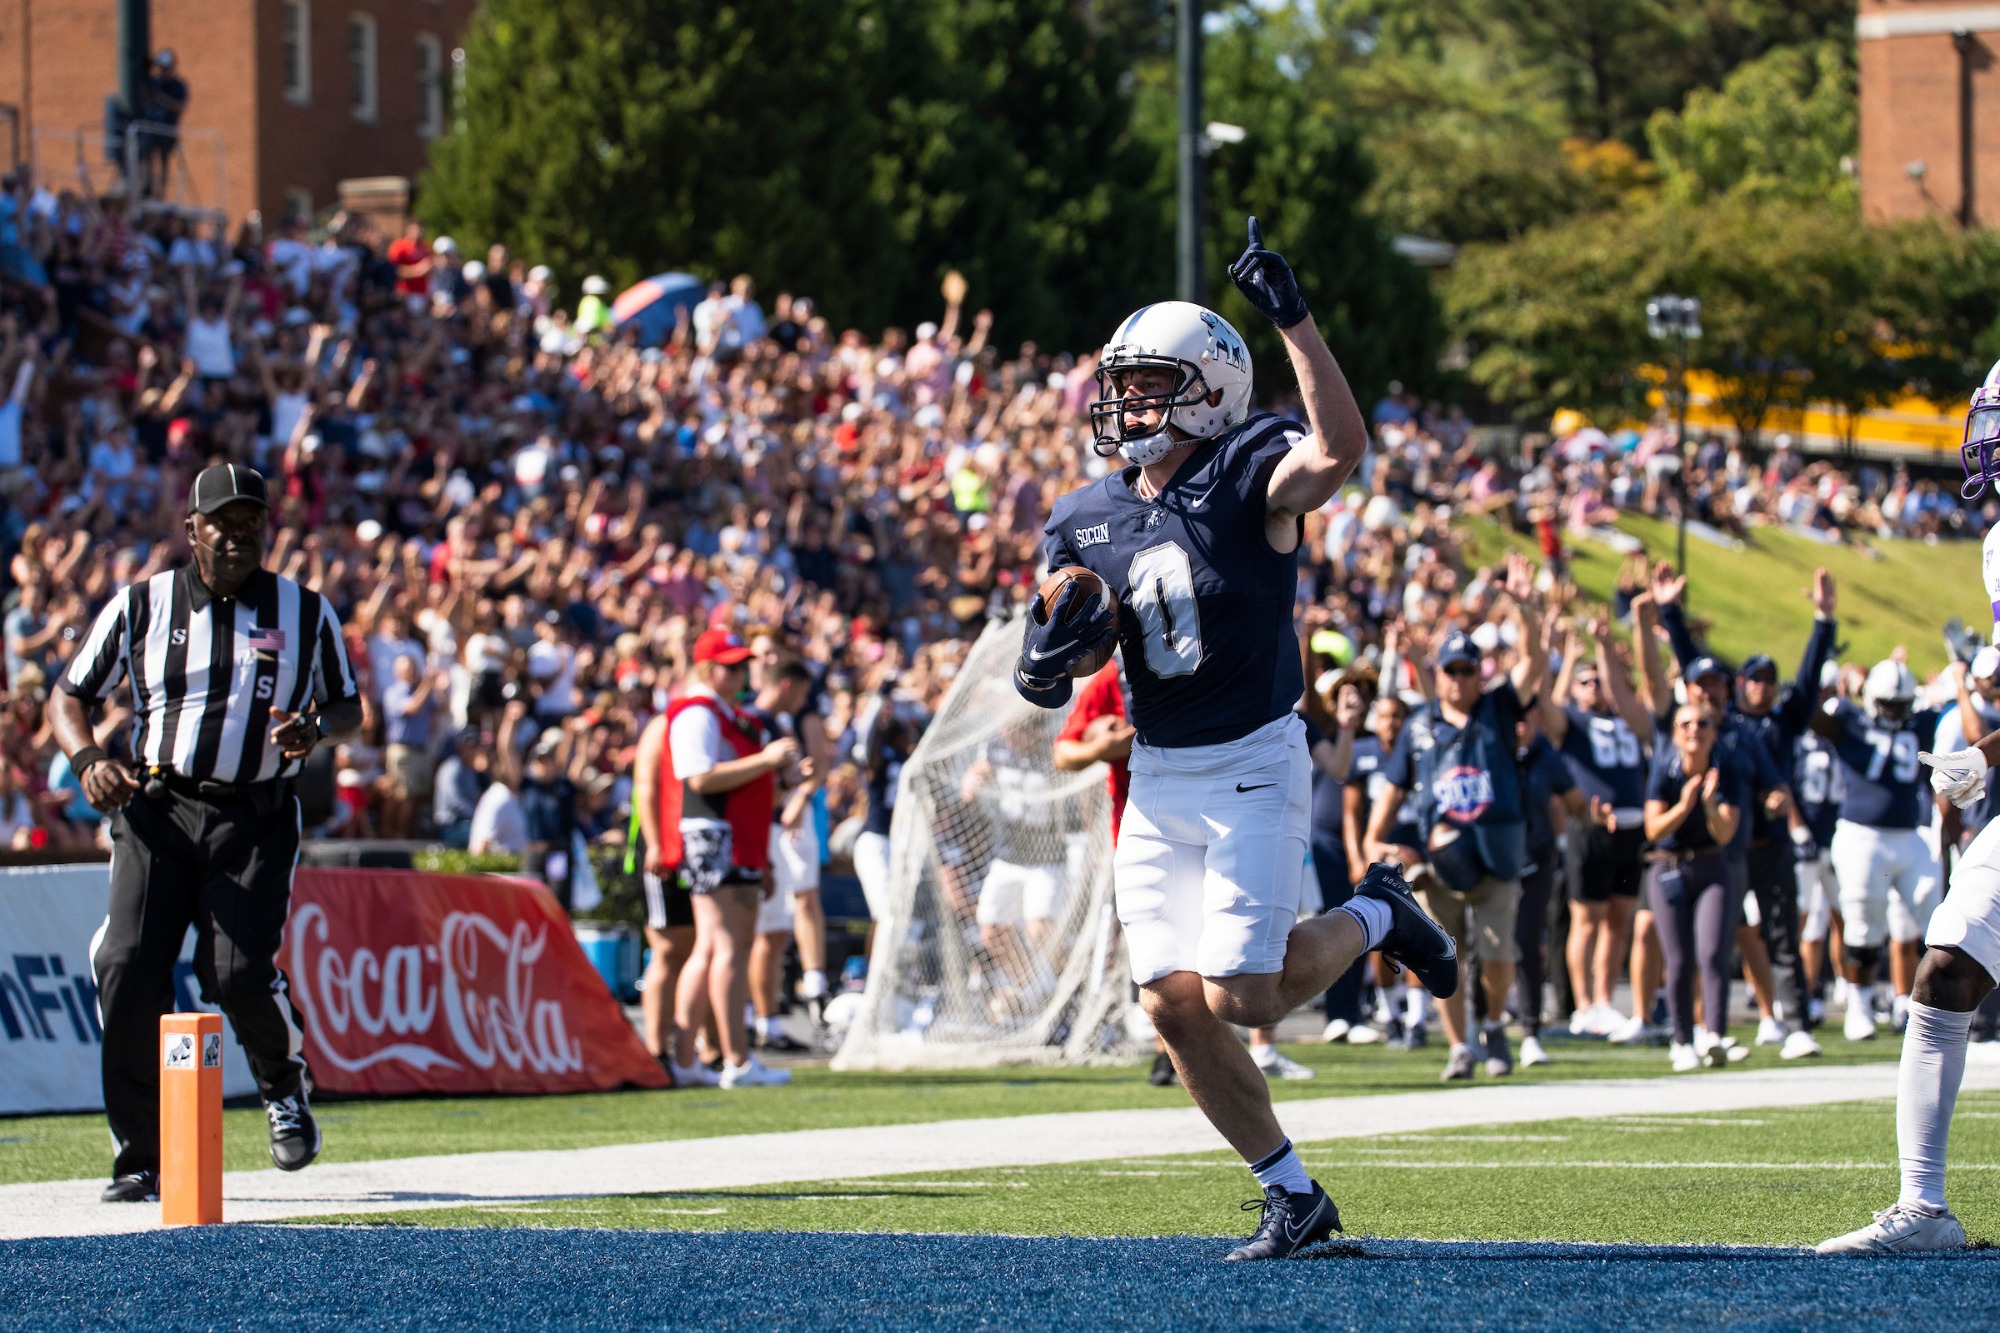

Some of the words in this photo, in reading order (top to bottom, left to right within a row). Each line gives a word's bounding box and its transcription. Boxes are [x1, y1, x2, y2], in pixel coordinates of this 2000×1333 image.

[1075, 522, 1110, 549] SOCON
[1128, 541, 1203, 680] 0
[171, 628, 187, 645] S
[255, 675, 275, 699] S
[1864, 729, 1920, 783] 79
[291, 902, 584, 1074] Coca-Cola
